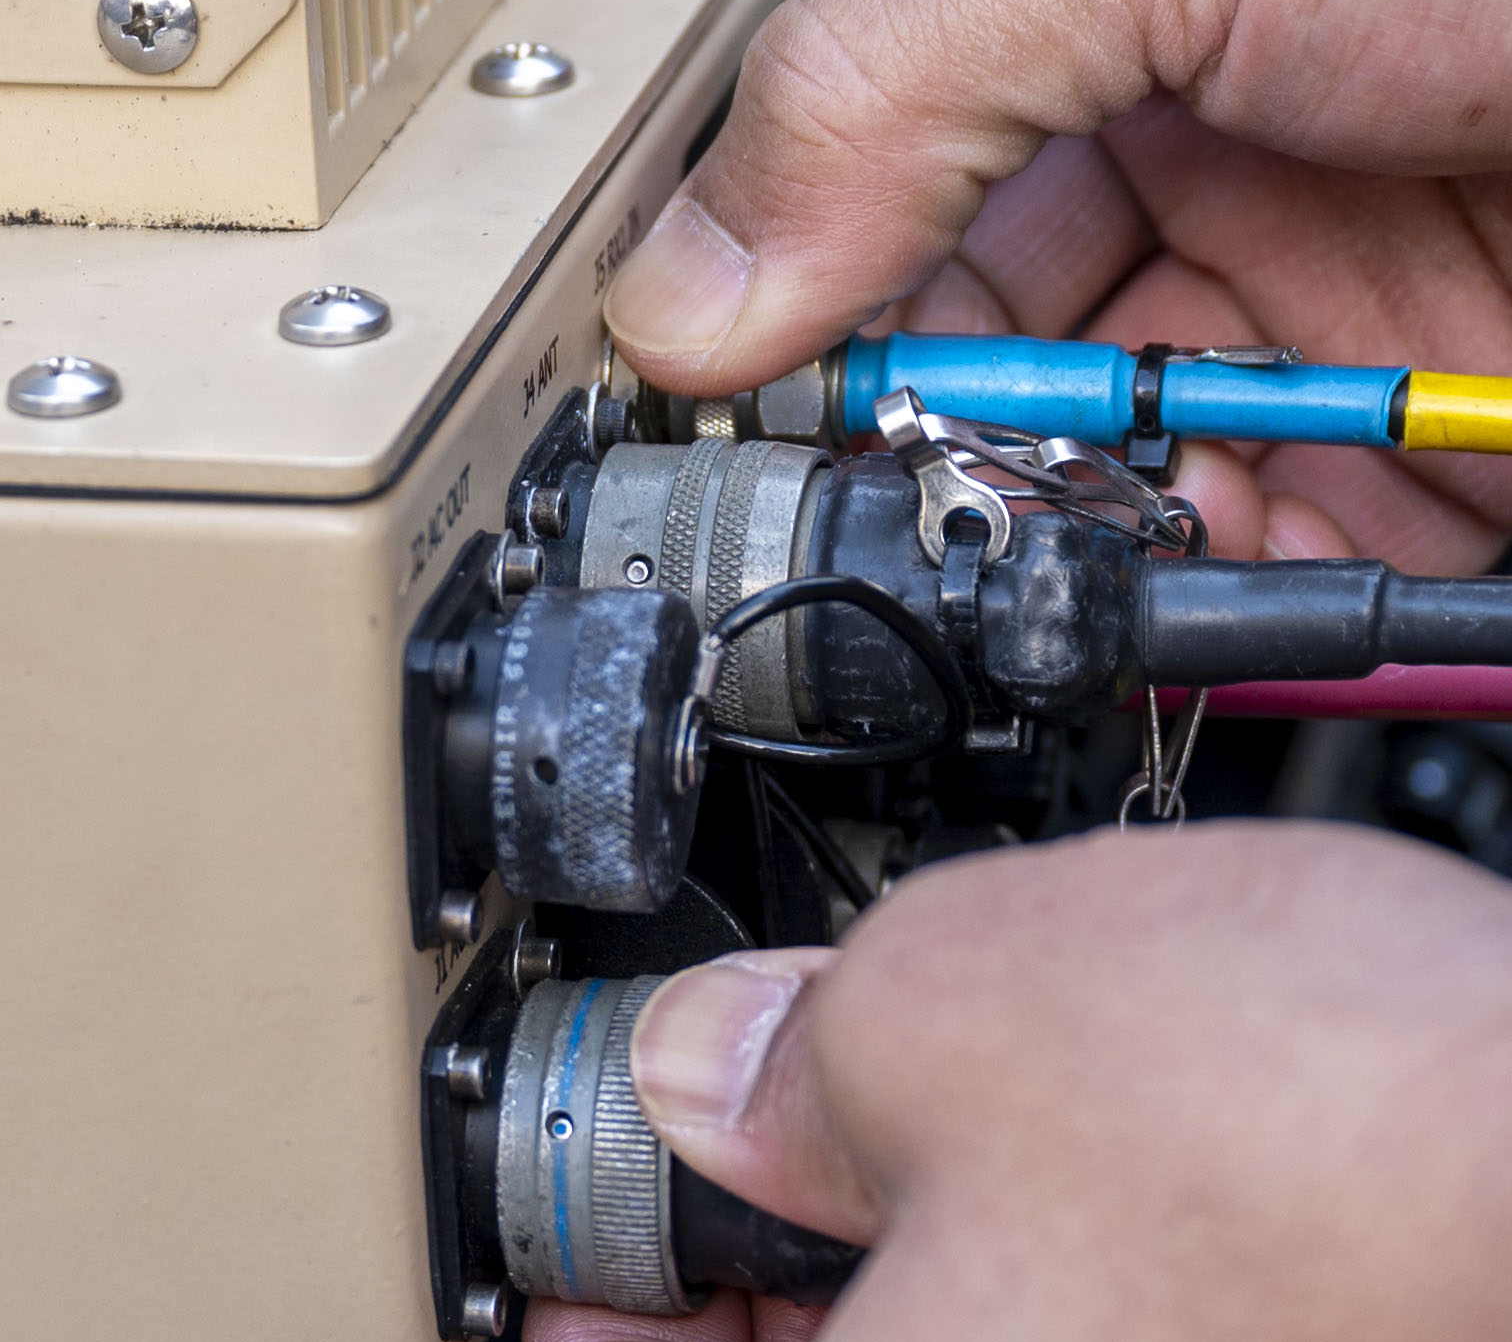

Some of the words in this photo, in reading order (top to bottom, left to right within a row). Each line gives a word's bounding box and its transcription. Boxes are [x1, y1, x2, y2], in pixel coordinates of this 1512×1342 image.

[523, 370, 536, 419] J4
[538, 334, 559, 400] ANT
[445, 463, 470, 530] OUT
